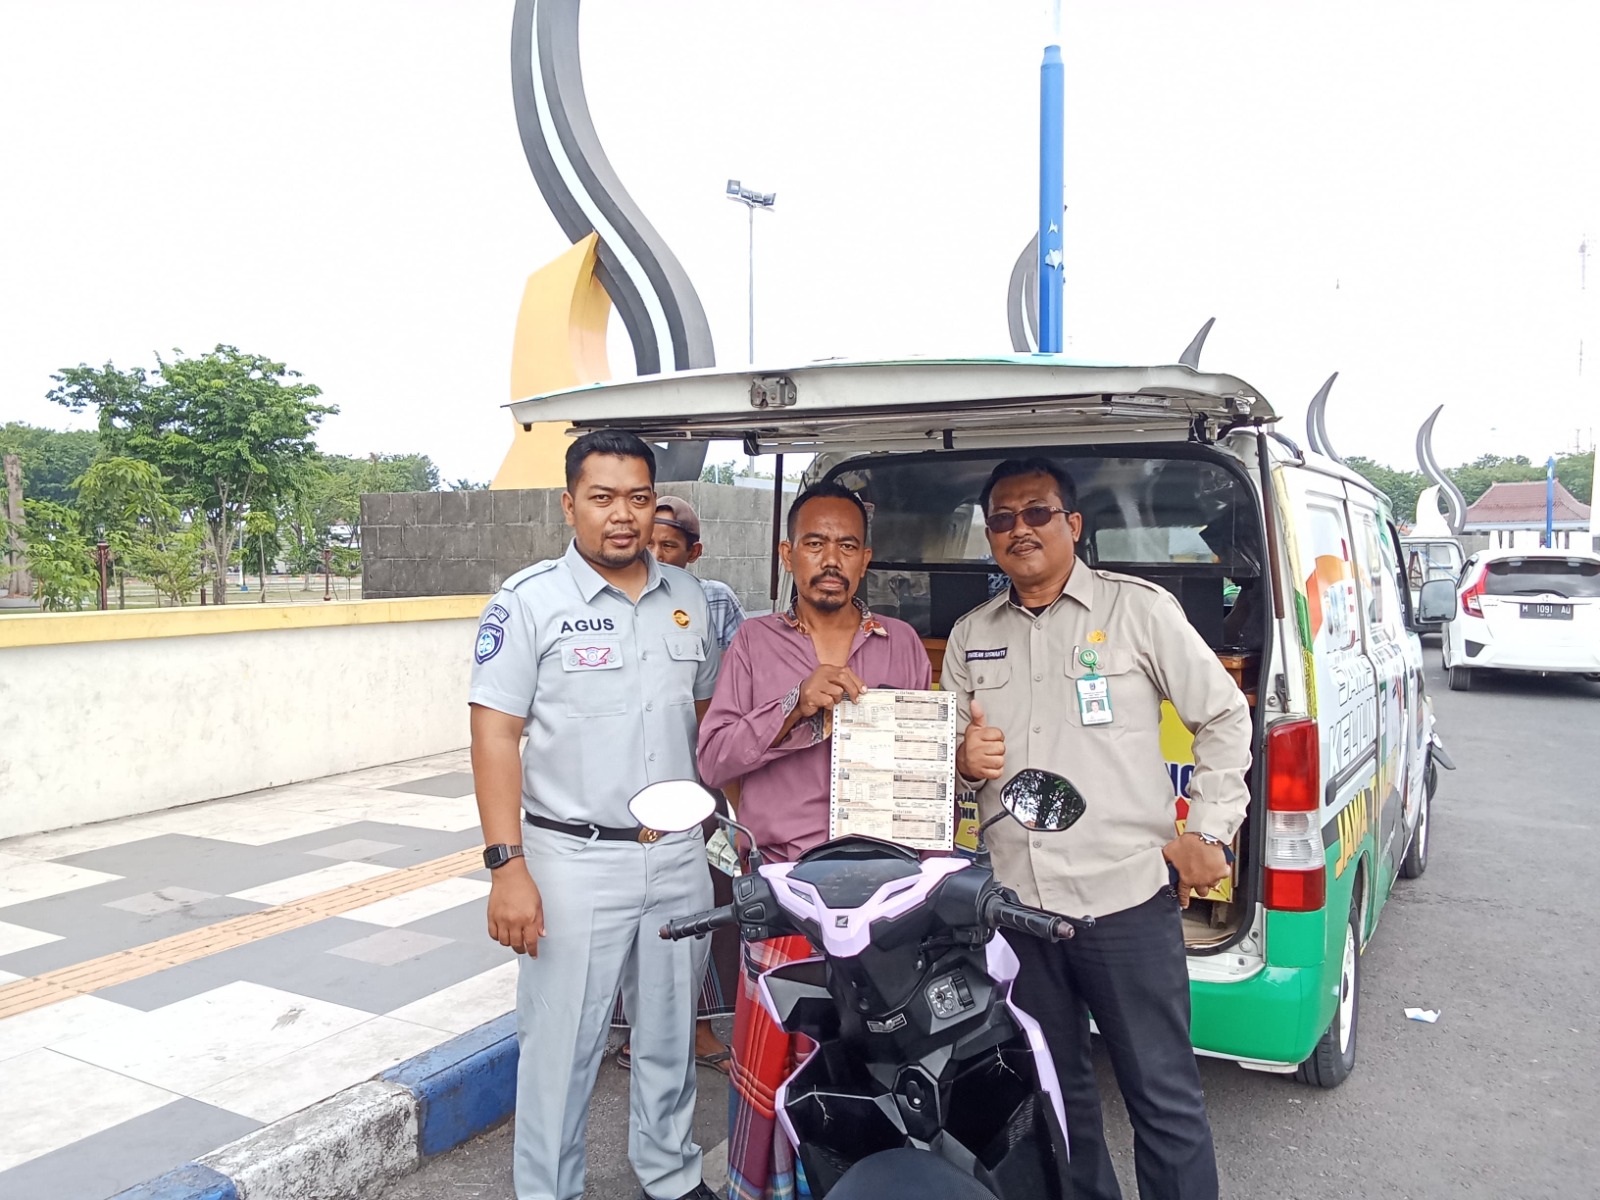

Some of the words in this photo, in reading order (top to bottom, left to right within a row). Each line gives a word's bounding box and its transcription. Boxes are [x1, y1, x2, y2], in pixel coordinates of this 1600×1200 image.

[1537, 605, 1553, 613] 1091
[560, 618, 615, 634] AGUS
[1335, 786, 1368, 881] JAWA
